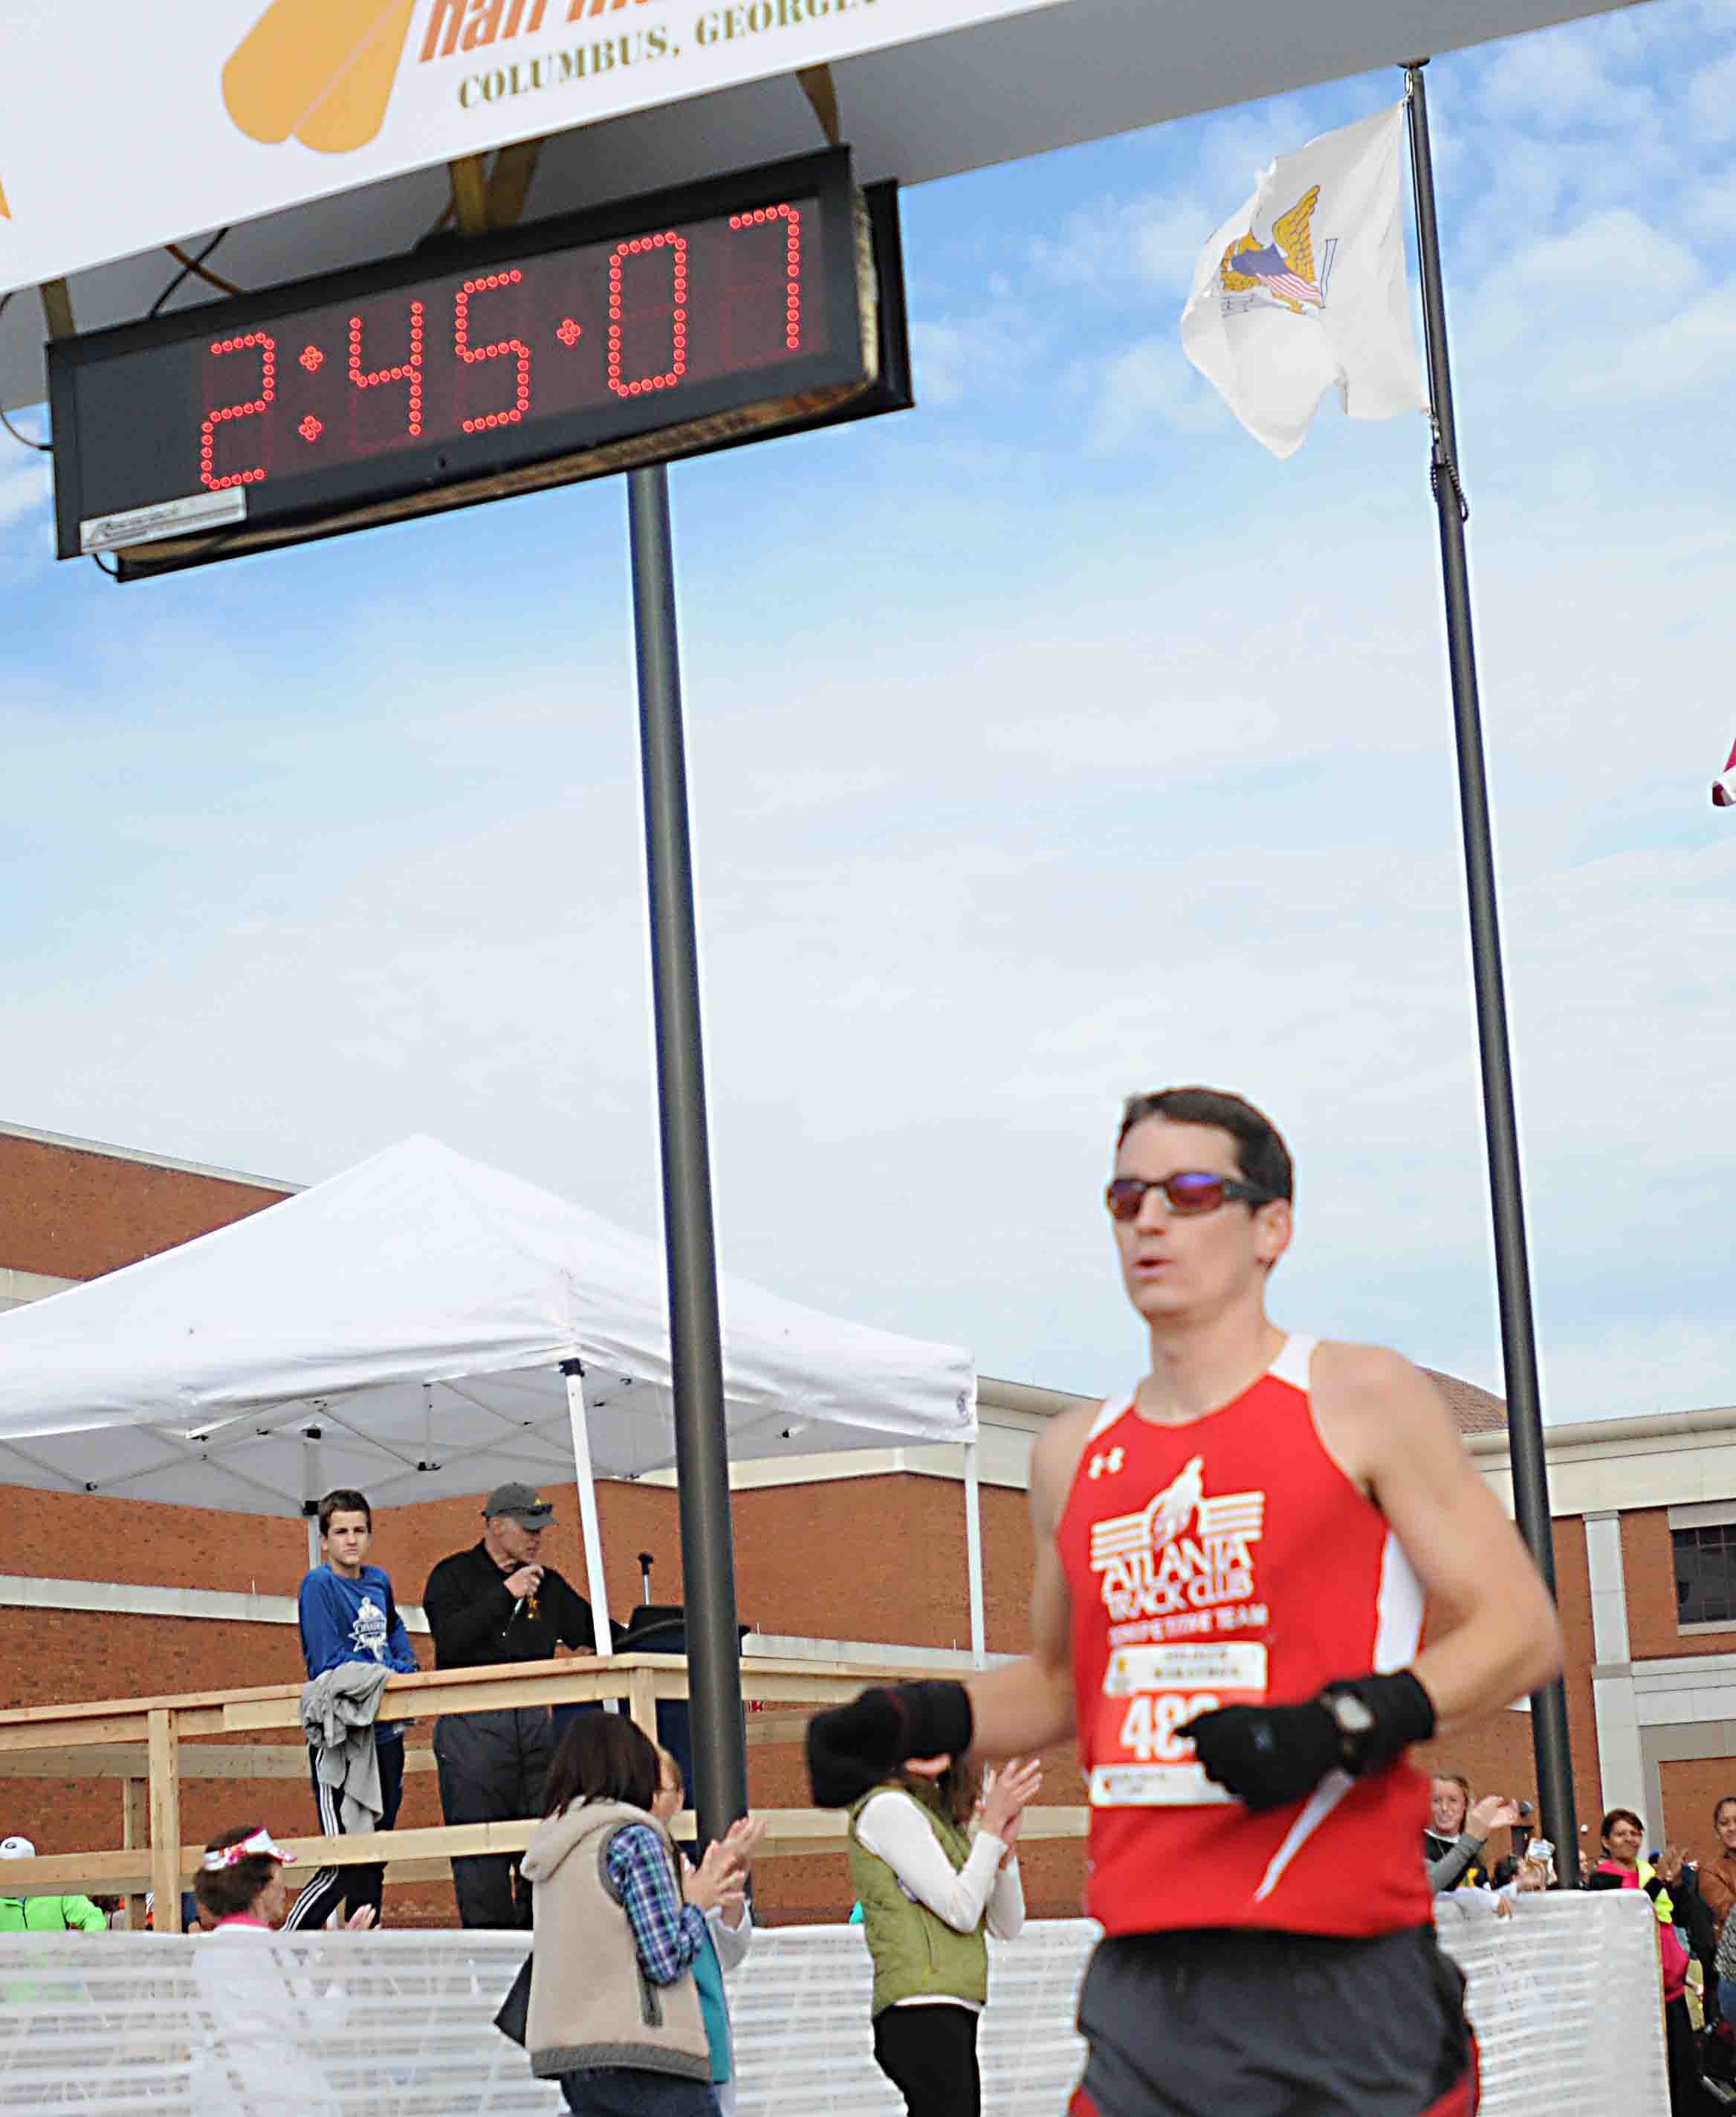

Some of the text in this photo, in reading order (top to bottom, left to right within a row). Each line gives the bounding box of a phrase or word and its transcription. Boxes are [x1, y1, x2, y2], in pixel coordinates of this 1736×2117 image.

[457, 0, 877, 108] COLUMBUS, GEORG
[1101, 1534, 1254, 1600] ATLANTA
[1107, 1568, 1254, 1620] TRACK CLUB
[1120, 1693, 1220, 1760] 48
